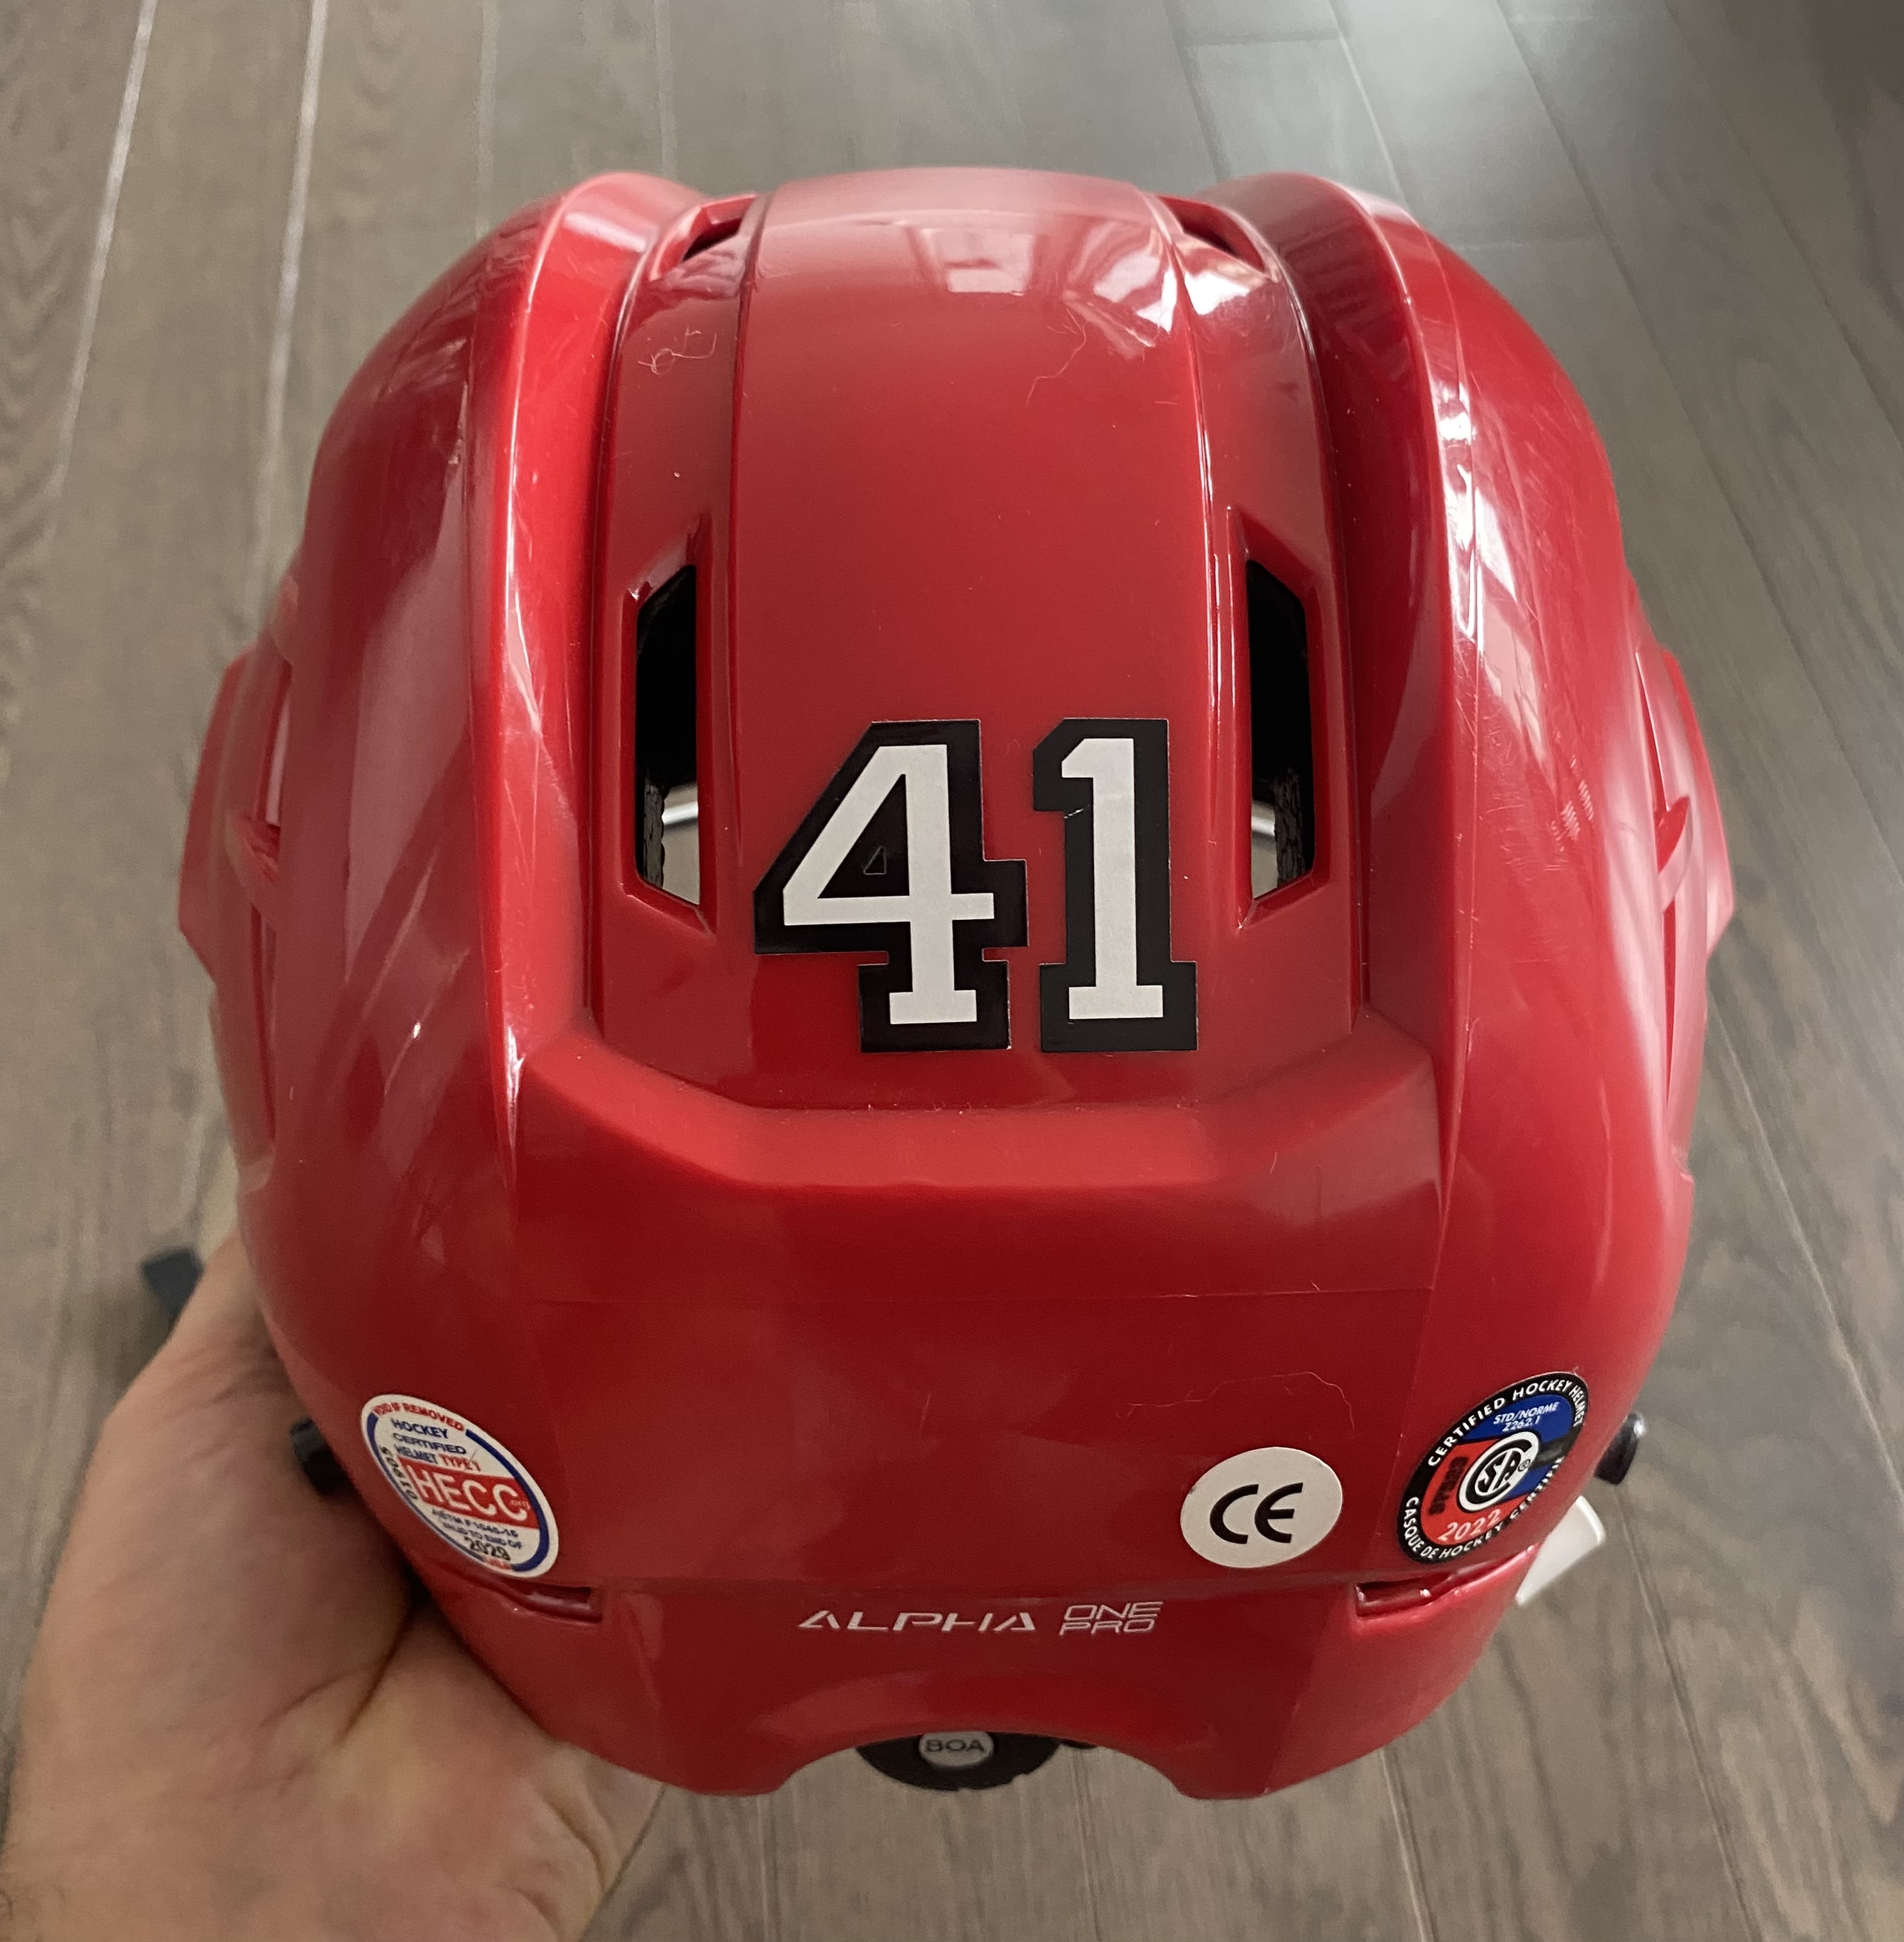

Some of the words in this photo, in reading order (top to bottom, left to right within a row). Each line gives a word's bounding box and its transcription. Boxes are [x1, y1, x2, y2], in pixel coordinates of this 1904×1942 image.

[754, 719, 1197, 1052] 41
[402, 1402, 465, 1431] REMOVED
[1427, 1397, 1505, 1467] CERTIFIED
[1512, 1379, 1572, 1401] HOCKEY
[1568, 1385, 1586, 1428] HELMET
[1493, 1401, 1560, 1424] STD/NORME
[1502, 1416, 1541, 1433] Z262.1
[390, 1418, 448, 1439] HOCKEY
[392, 1433, 467, 1455] CERTIFIED
[394, 1443, 438, 1464] HELMET
[438, 1453, 473, 1470] TYPE
[406, 1465, 528, 1521] HECC
[1210, 1482, 1303, 1545] CE
[1437, 1508, 1502, 1542] 2022
[1403, 1496, 1425, 1552] CASQUE
[1420, 1546, 1439, 1559] DE
[1439, 1521, 1504, 1559] HOCKEY
[798, 1610, 1036, 1633] ALPHA
[1063, 1601, 1164, 1621] ONE
[1058, 1618, 1155, 1636] PRO
[924, 1739, 985, 1753] BOA
